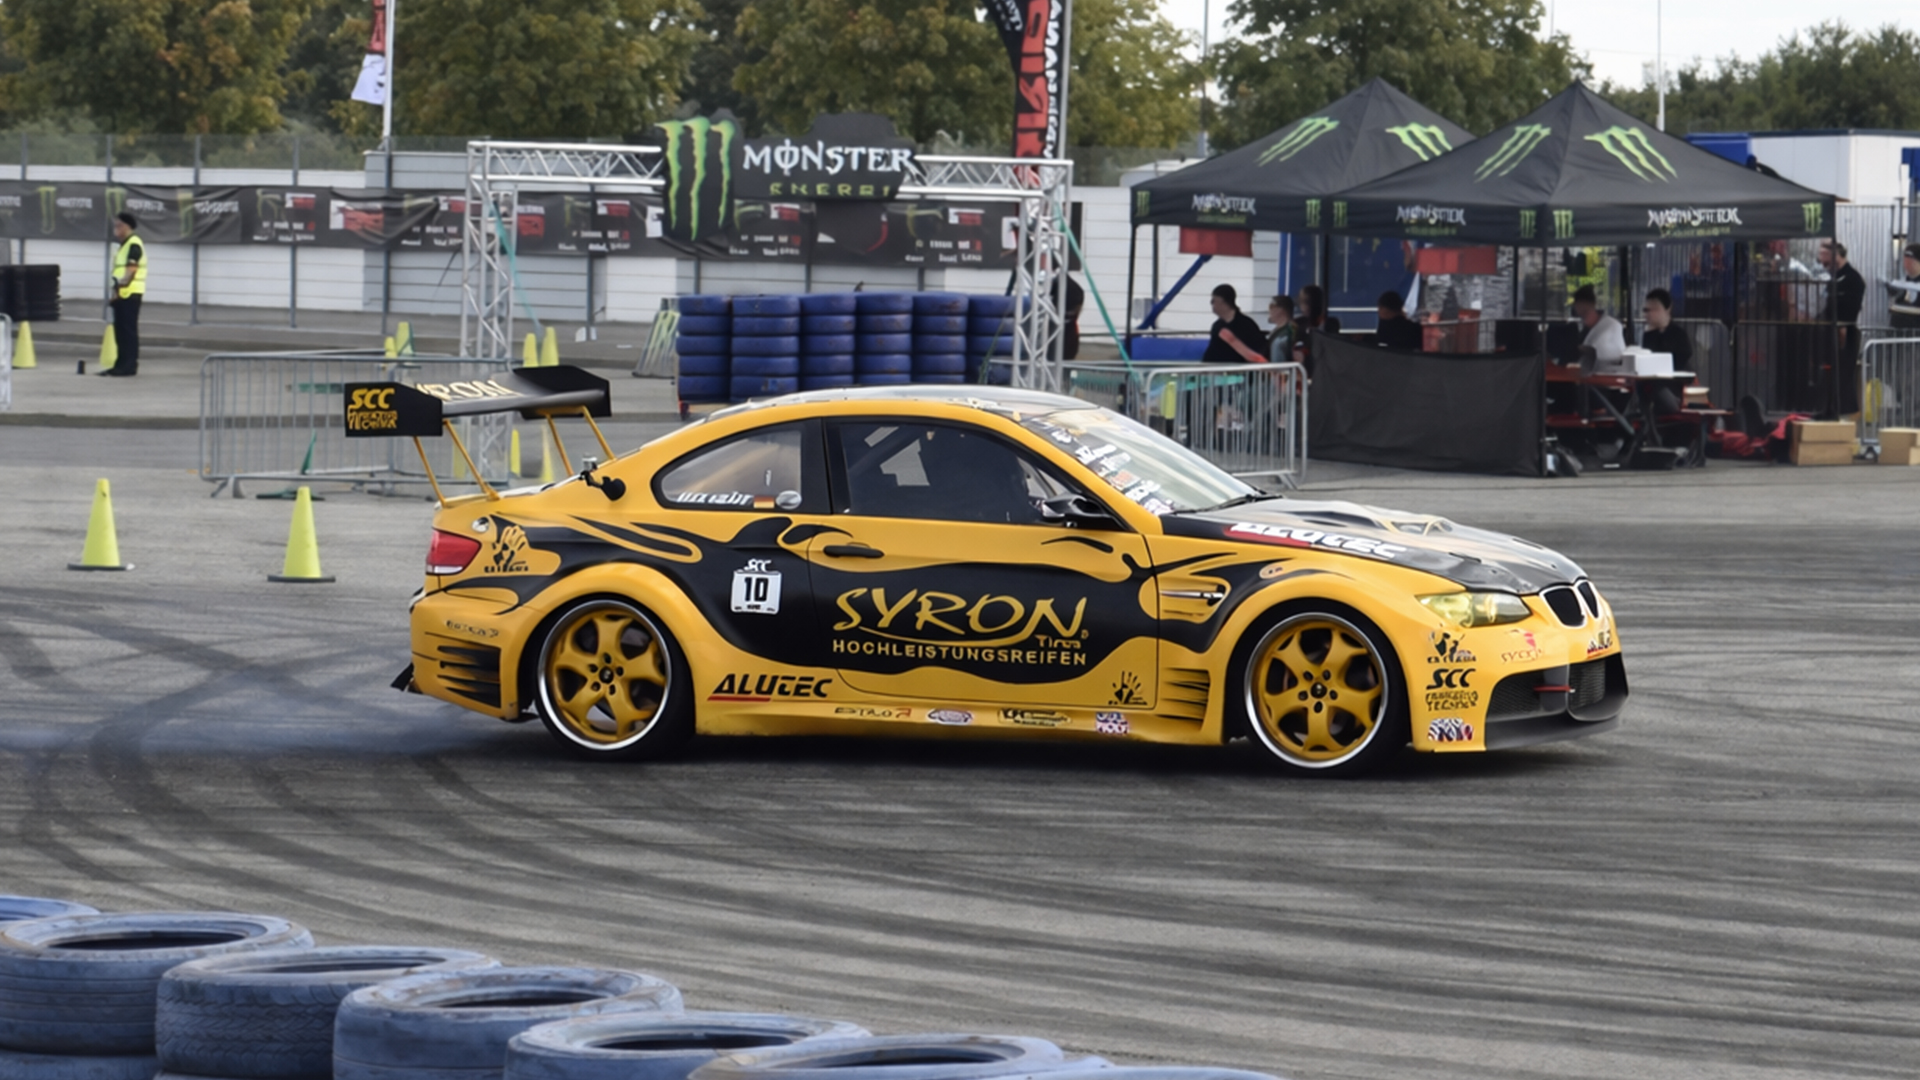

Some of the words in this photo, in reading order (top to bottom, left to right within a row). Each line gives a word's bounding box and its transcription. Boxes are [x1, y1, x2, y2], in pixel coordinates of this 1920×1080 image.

[742, 138, 922, 177] MONSTER
[351, 388, 395, 409] SCC
[744, 577, 769, 602] 10
[832, 587, 1088, 643] SYRON
[832, 639, 1087, 666] HOCHLEISTUNGSREIFEN
[712, 673, 833, 698] ALUTEC
[1425, 668, 1476, 690] SCC
